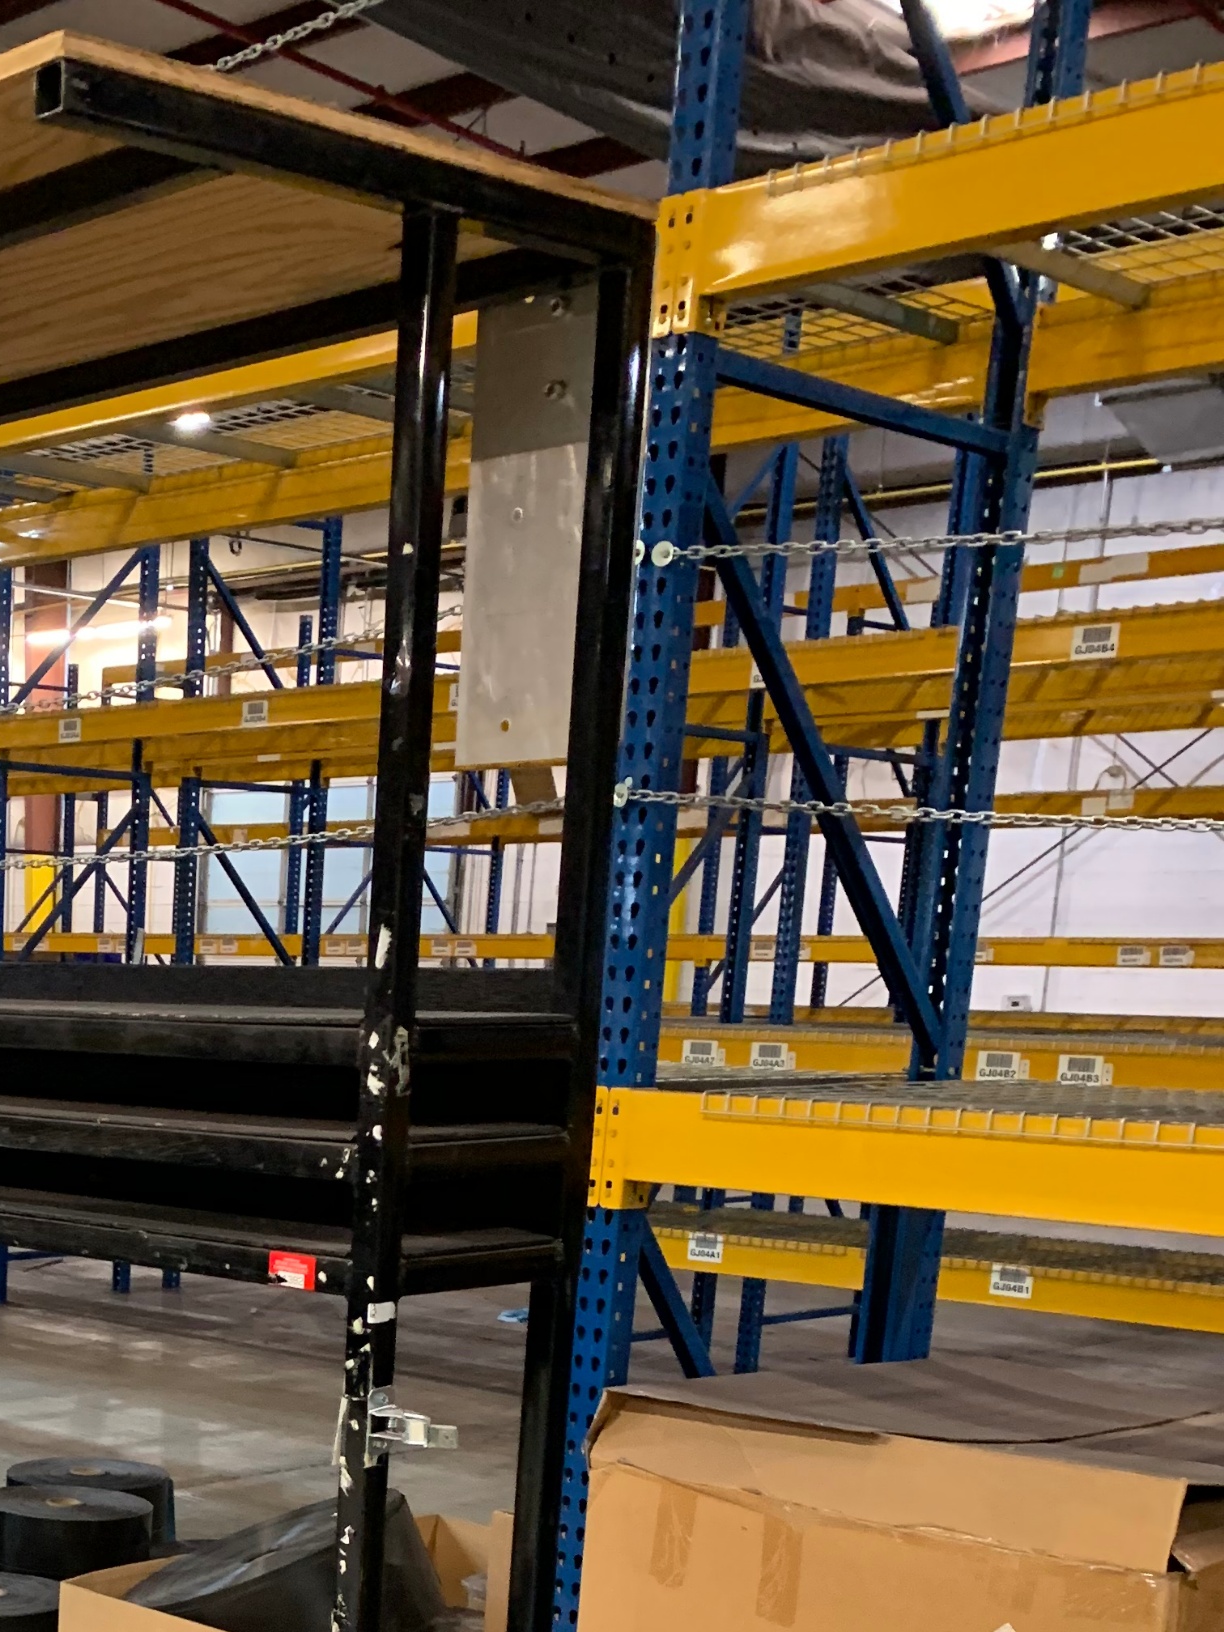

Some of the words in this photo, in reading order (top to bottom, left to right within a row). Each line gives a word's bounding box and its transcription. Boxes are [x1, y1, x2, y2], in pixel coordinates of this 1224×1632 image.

[979, 1068, 1017, 1079] GJ04B2
[1060, 1072, 1100, 1083] GJ04B3
[993, 1282, 1030, 1295] GJ04B1
